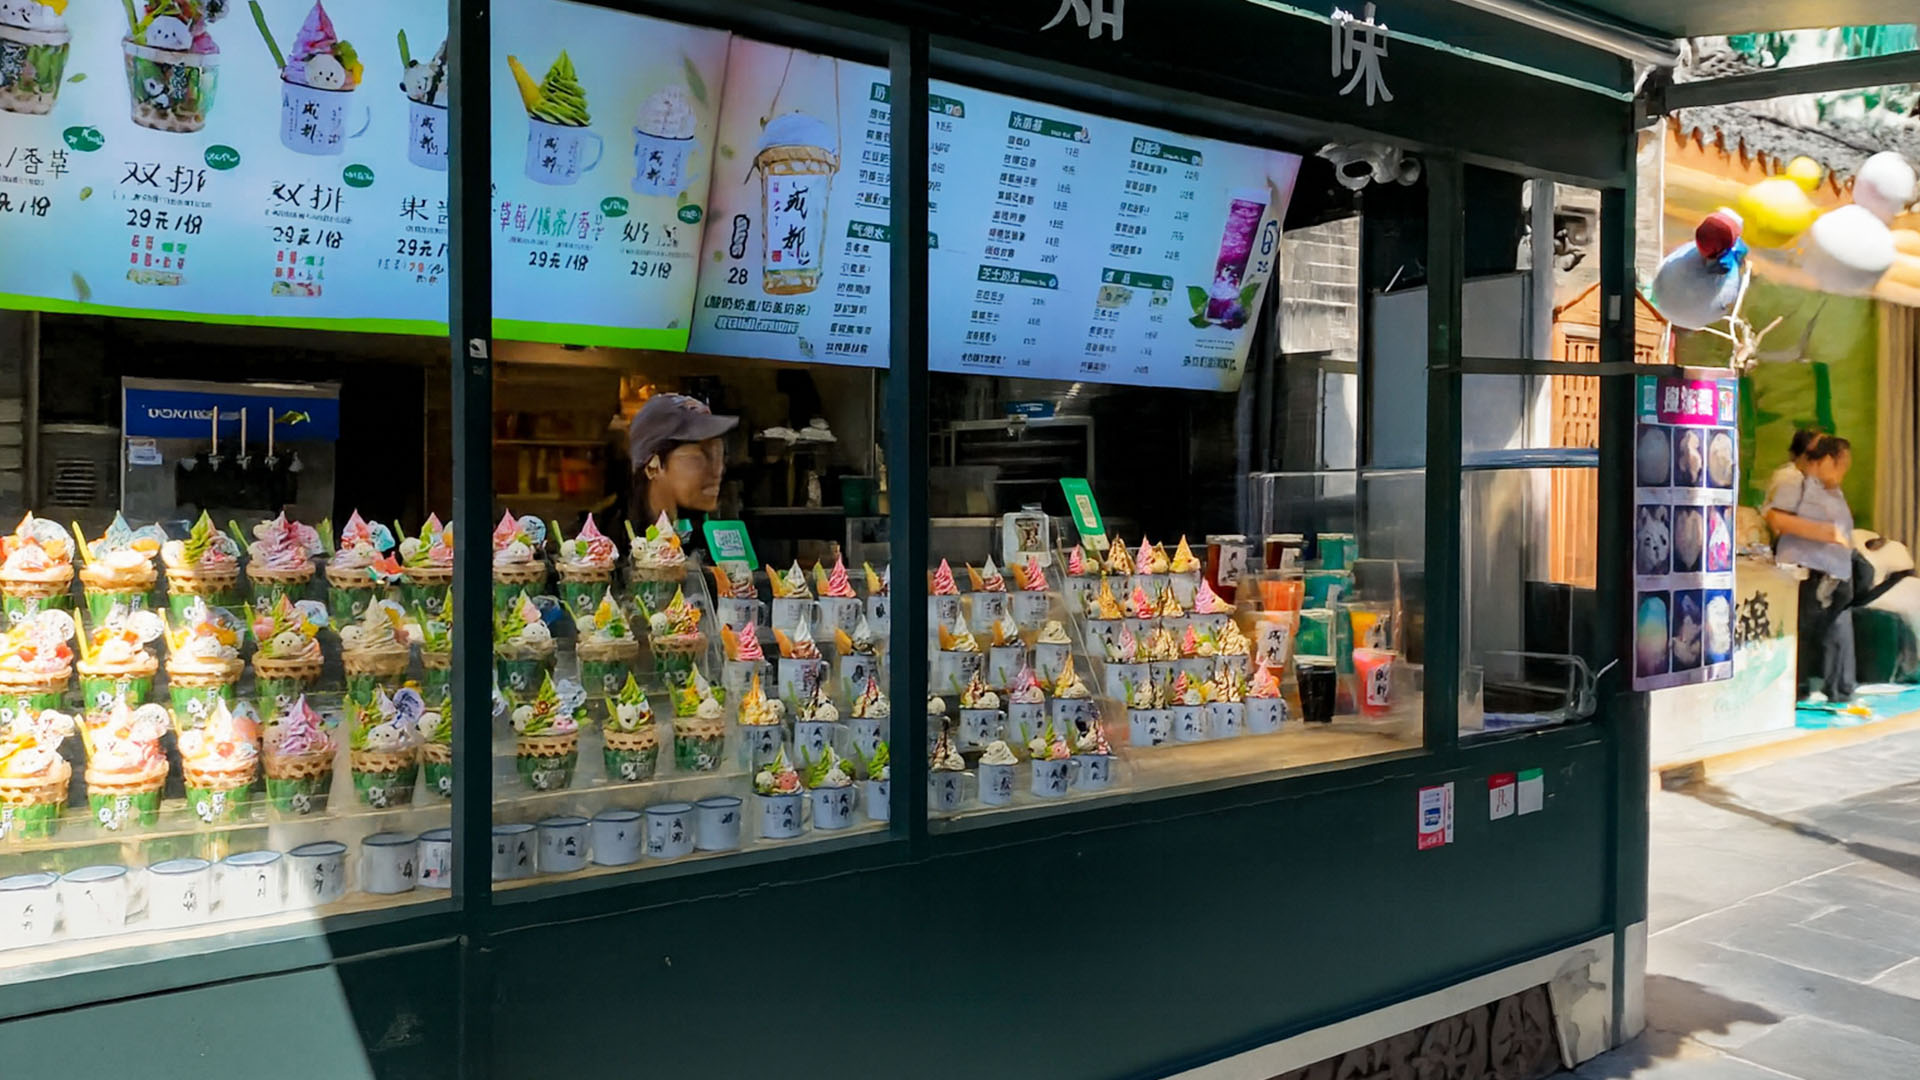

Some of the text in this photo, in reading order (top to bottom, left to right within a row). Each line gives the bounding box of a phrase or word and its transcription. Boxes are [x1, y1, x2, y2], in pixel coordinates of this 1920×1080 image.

[1331, 2, 1394, 106] 味
[126, 208, 203, 236] 29元/份
[397, 239, 448, 258] 29元/
[728, 267, 749, 286] 28
